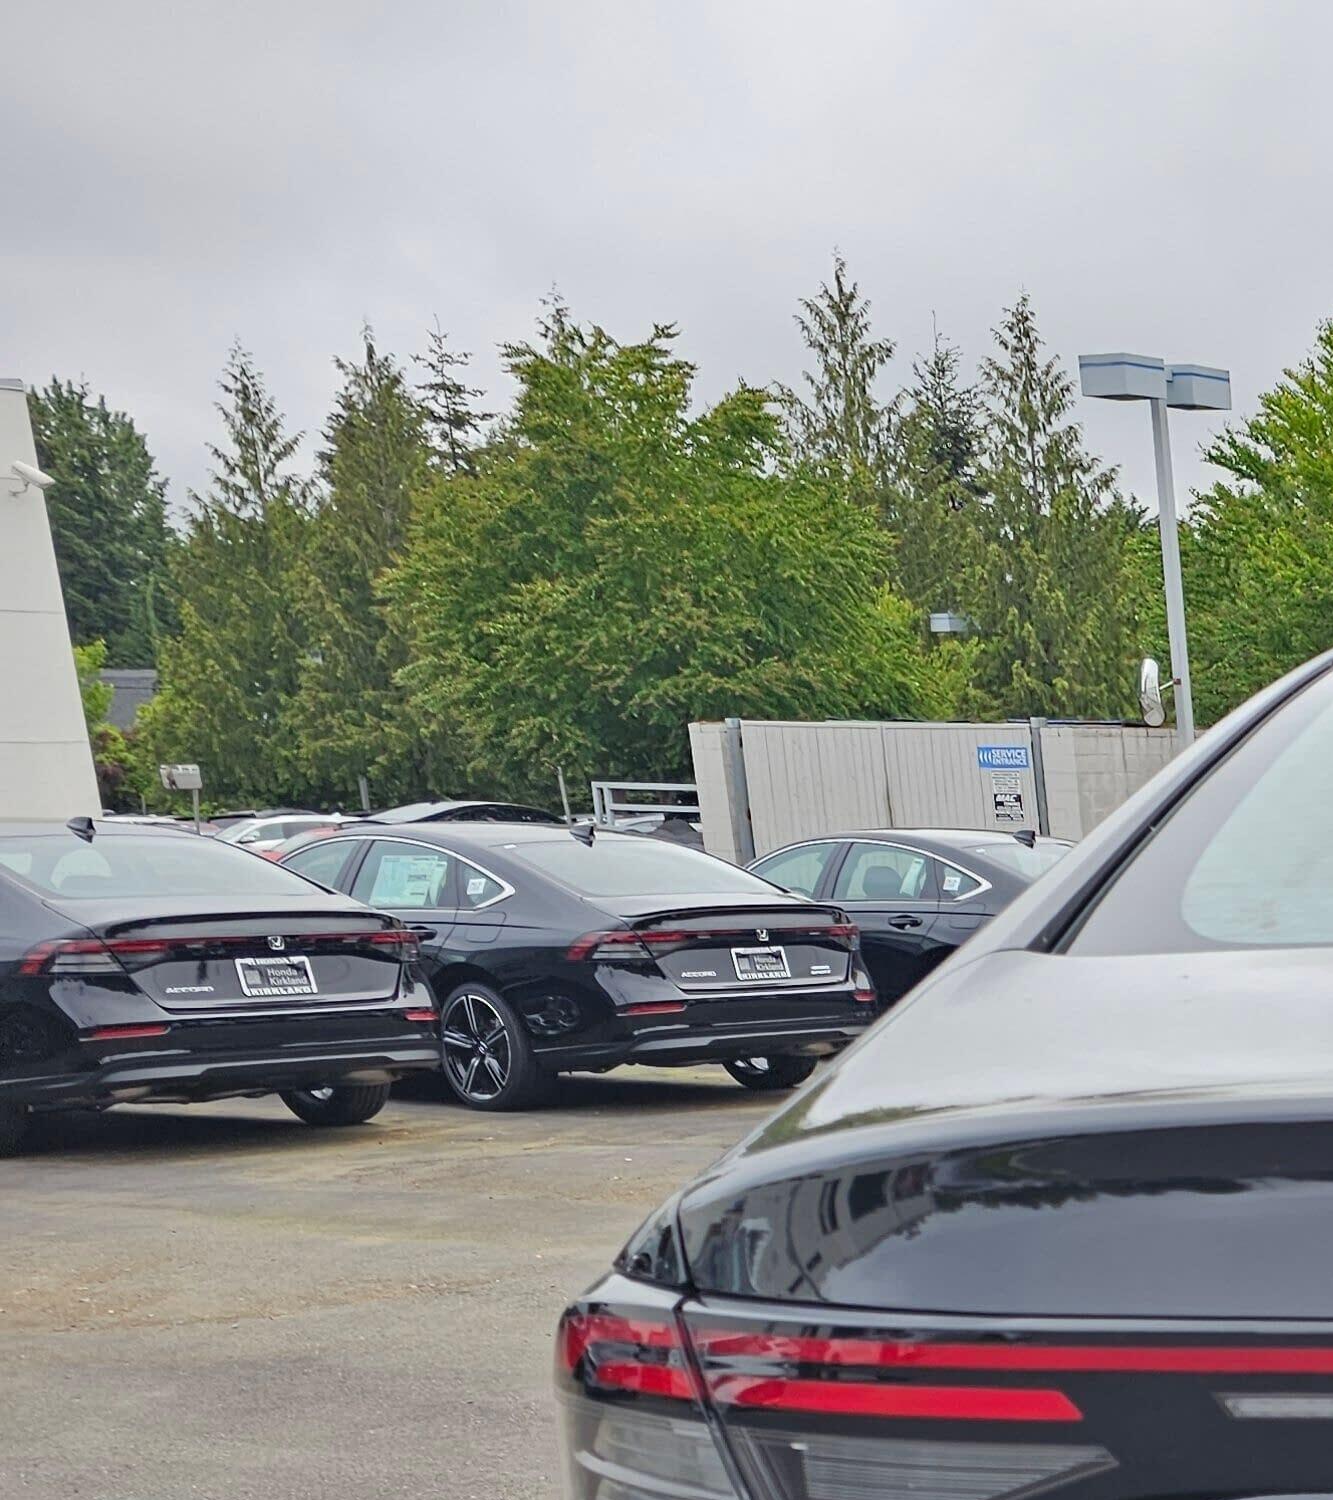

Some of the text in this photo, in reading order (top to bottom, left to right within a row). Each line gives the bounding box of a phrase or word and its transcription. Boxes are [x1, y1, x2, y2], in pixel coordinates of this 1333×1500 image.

[992, 749, 1026, 759] SERVICE
[266, 966, 298, 977] Honda
[269, 976, 309, 986] Kirkland
[250, 985, 312, 995] KIRKLAND
